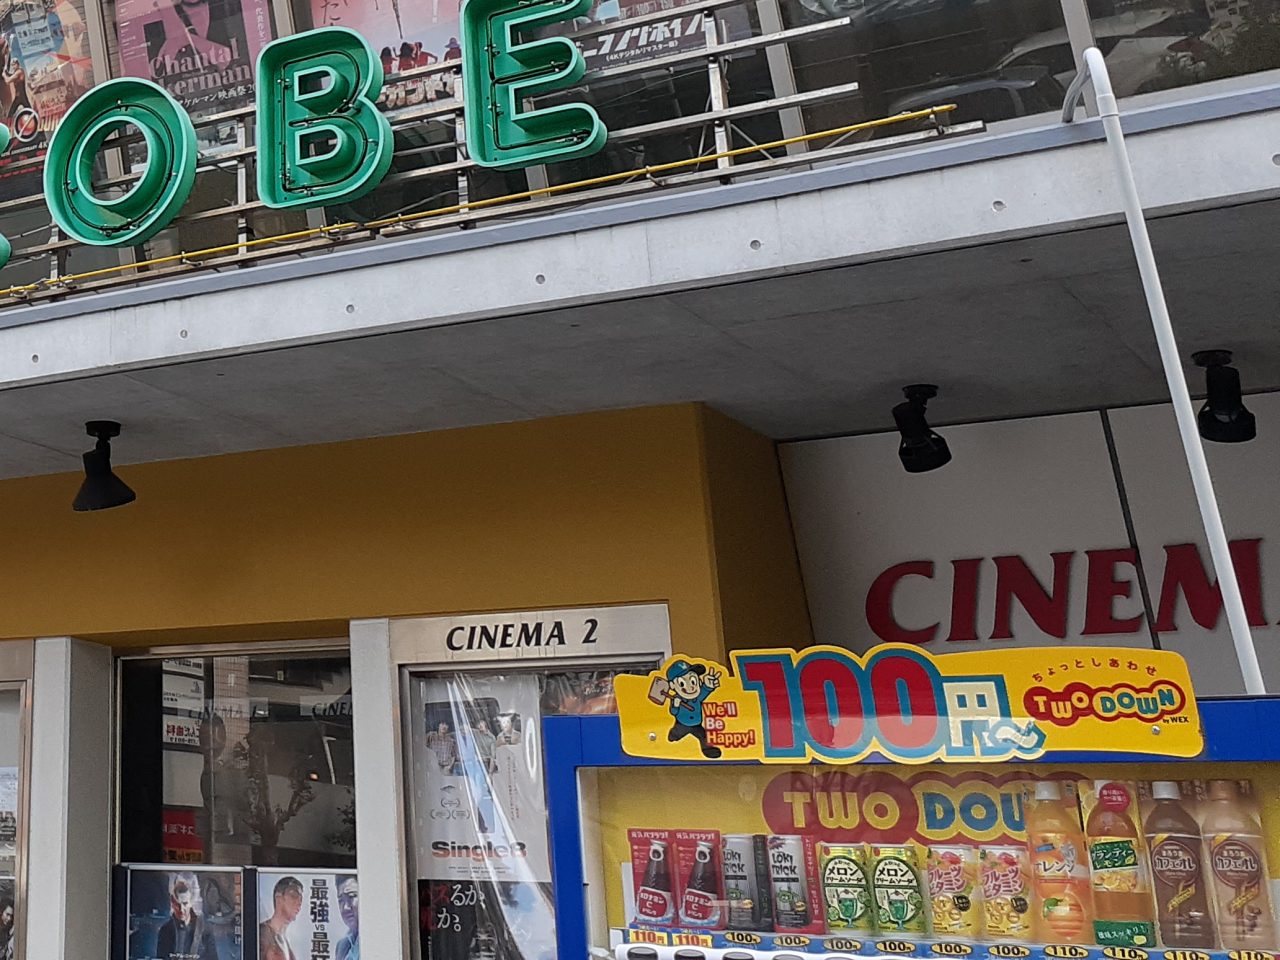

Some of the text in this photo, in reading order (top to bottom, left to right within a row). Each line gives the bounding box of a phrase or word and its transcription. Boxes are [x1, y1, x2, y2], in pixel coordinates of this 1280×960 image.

[161, 63, 252, 97] kerman
[865, 538, 1280, 644] CINEM
[446, 619, 599, 651] CINEMA 2
[1032, 657, 1157, 682] ちょっとしあわせ
[703, 702, 736, 717] We'll
[1033, 688, 1175, 719] TWO DOWN
[705, 717, 724, 731] Be
[706, 731, 755, 748] Happy!
[783, 791, 900, 829] TWO
[771, 863, 797, 875] TRICK
[827, 866, 859, 878] メロン
[875, 866, 907, 878] メロン
[645, 901, 652, 909] C
